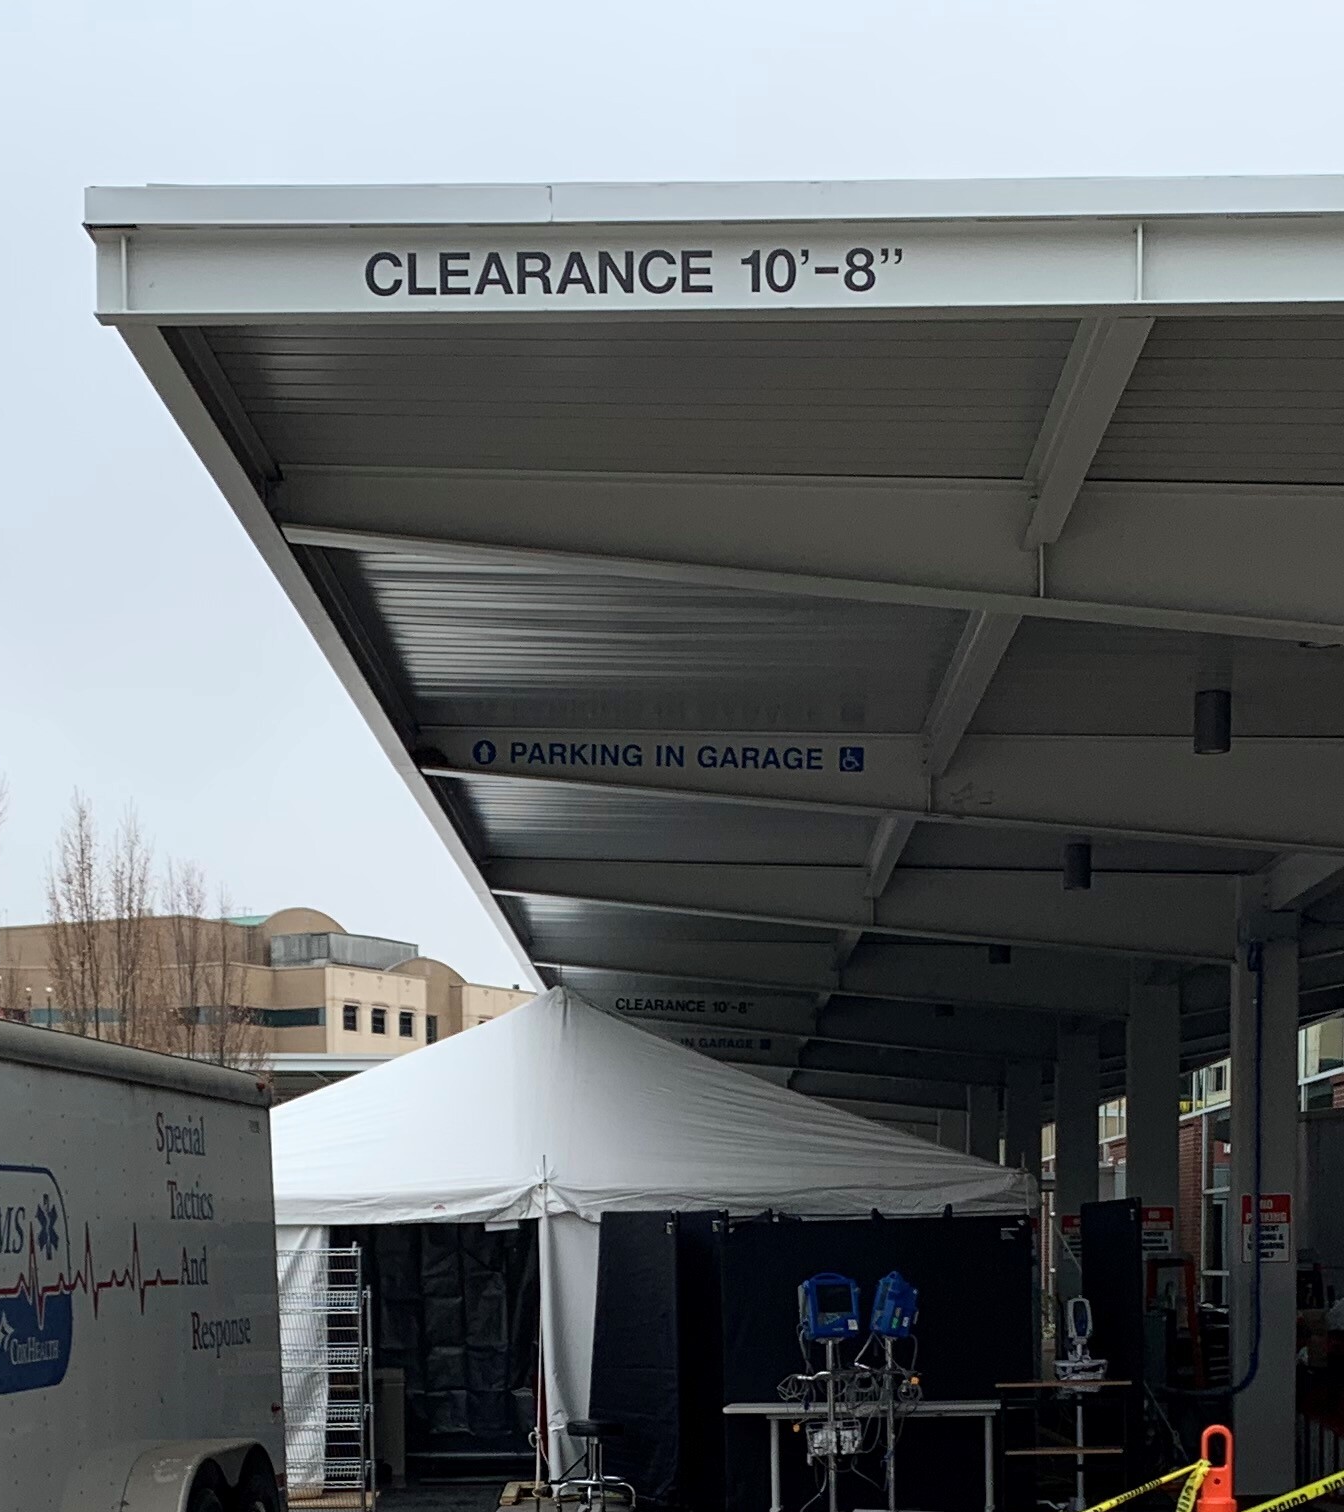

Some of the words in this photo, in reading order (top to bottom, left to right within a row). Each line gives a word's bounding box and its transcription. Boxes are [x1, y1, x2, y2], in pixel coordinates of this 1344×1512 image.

[364, 248, 714, 297] CLEARANCE
[510, 742, 643, 767] PARKING
[657, 744, 685, 768] IN
[697, 745, 824, 771] GARAGE
[615, 998, 705, 1013] CLEARANCE
[699, 1038, 753, 1050] GARAGE
[156, 1112, 206, 1165] Special
[167, 1180, 214, 1221] Tactics
[180, 1246, 208, 1286] And
[191, 1311, 251, 1359] Response
